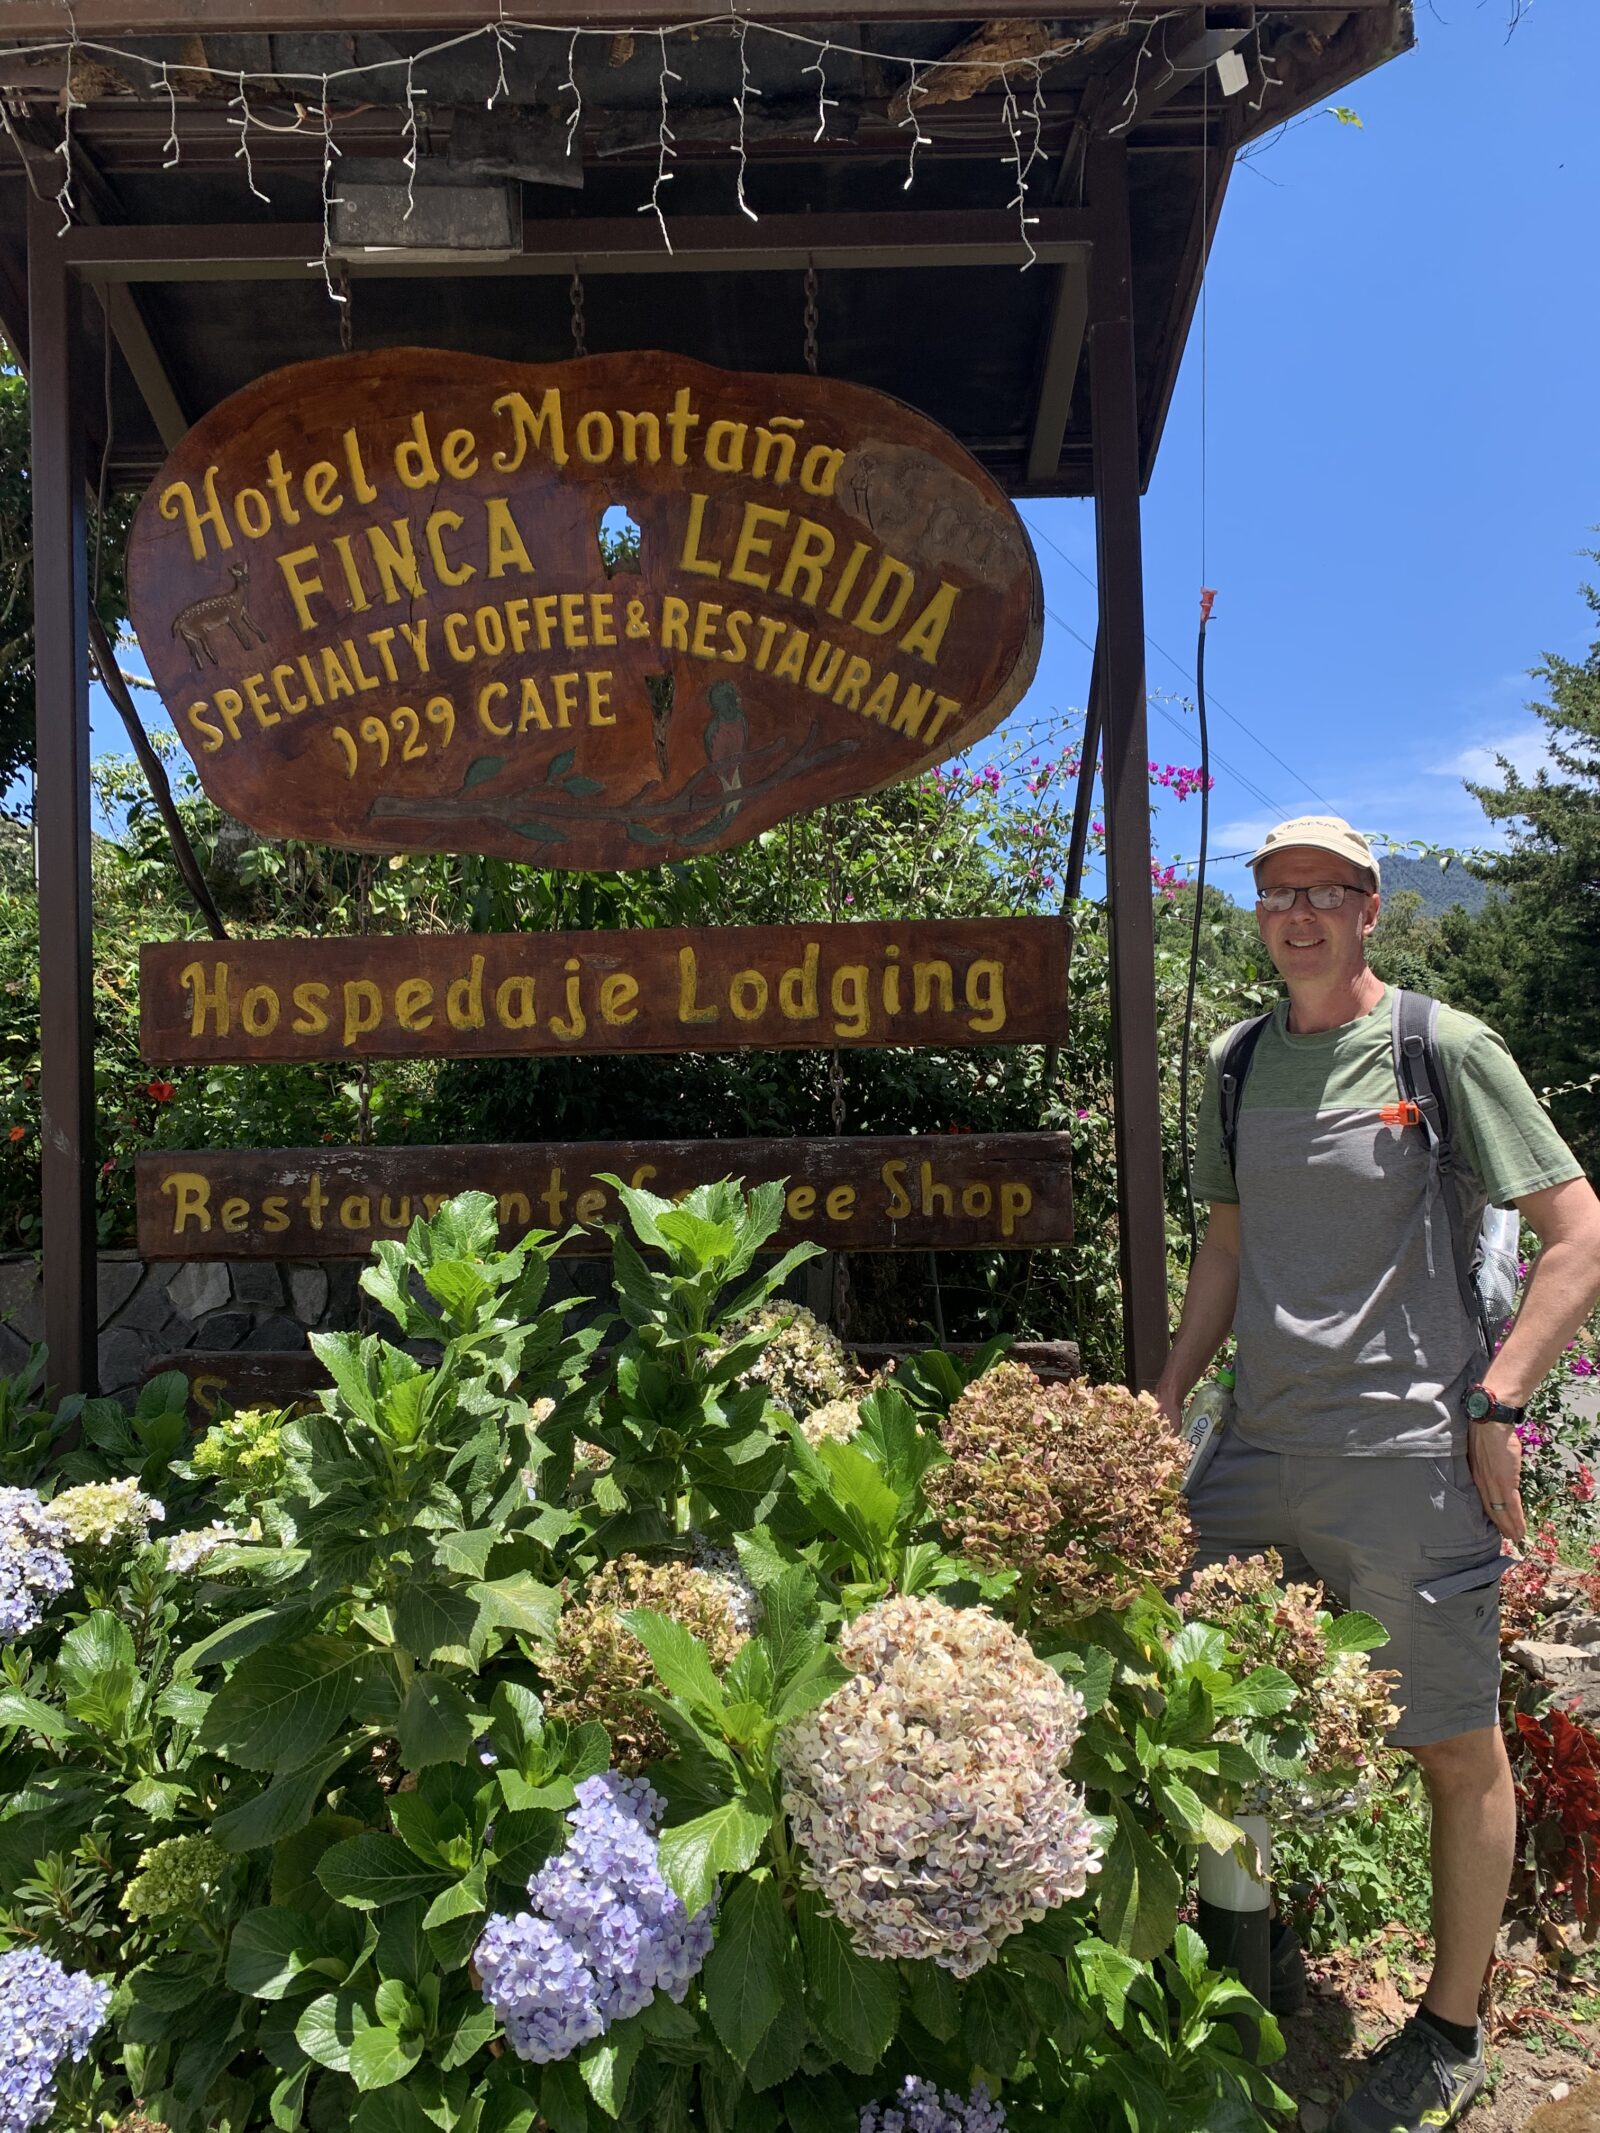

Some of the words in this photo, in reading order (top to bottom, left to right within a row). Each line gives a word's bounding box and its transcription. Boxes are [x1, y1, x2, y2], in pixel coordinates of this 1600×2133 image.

[159, 427, 377, 560] Hotel
[394, 411, 479, 490] de
[491, 387, 846, 497] Montaña
[276, 498, 535, 631] FINCA
[678, 493, 961, 665] LERIDA
[188, 619, 430, 753] SPECIALTY
[443, 593, 617, 663] COFFEE
[624, 600, 650, 639] &
[660, 596, 962, 746] RESTAURANT
[331, 696, 456, 779] 1929
[478, 671, 617, 736] CAFE
[179, 953, 640, 1046] Hospedaje
[678, 942, 1007, 1038] Lodging
[160, 1166, 607, 1235] Restaurnte
[881, 1159, 1033, 1237] Shop
